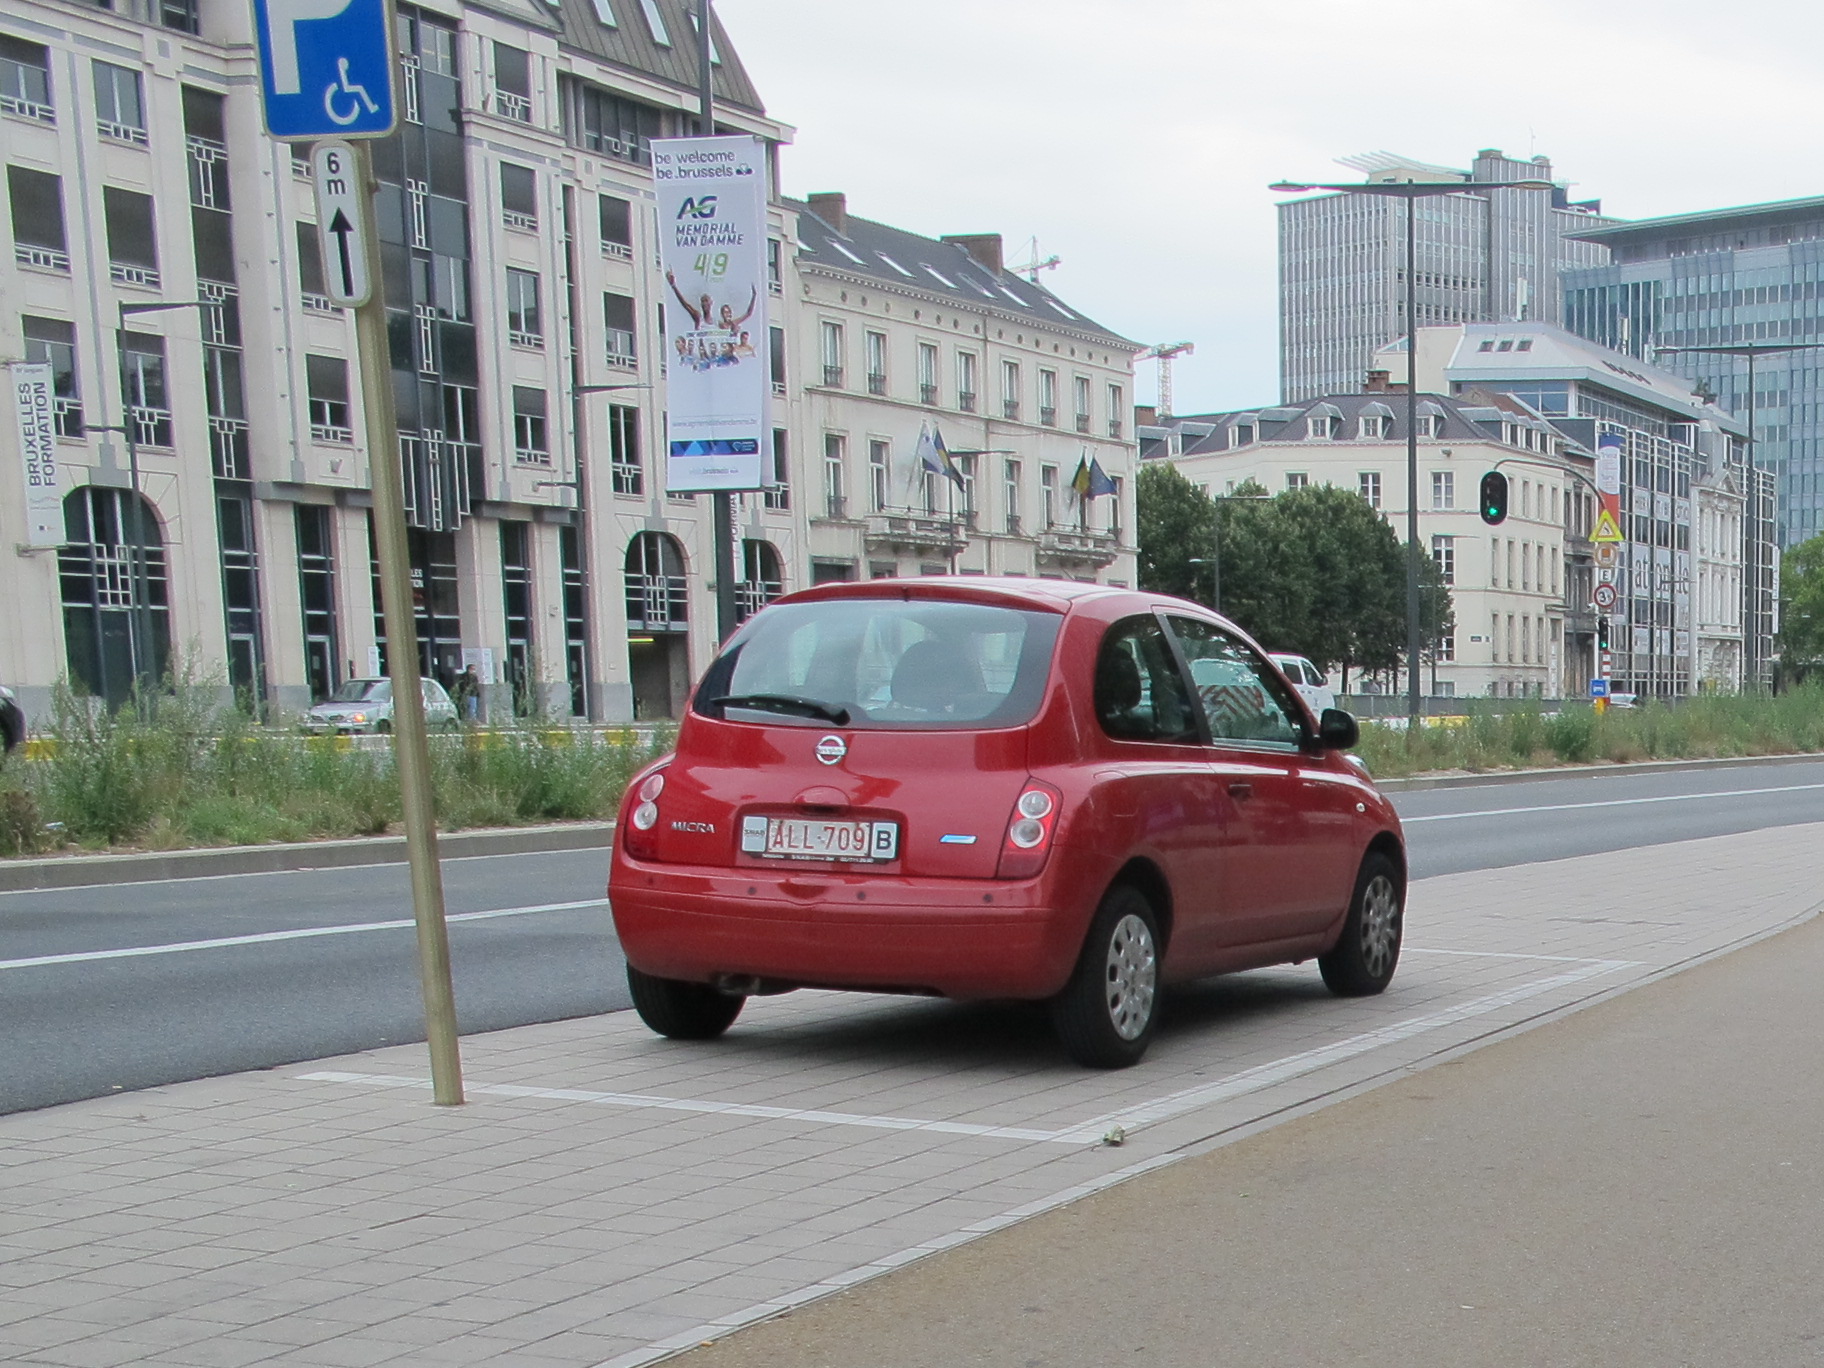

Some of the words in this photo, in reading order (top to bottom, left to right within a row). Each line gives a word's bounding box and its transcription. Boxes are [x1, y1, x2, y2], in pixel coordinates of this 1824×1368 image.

[326, 152, 341, 174] 6
[654, 152, 672, 165] be
[676, 150, 737, 164] welcome
[327, 178, 347, 195] m
[676, 195, 718, 220] AG
[675, 222, 737, 236] MEMORIAL
[675, 235, 699, 247] VAN
[700, 233, 744, 246] DAMME
[18, 382, 42, 487] BRUXELLES
[33, 381, 57, 487] FORMATION
[671, 821, 716, 834] MICRA
[876, 830, 892, 850] B
